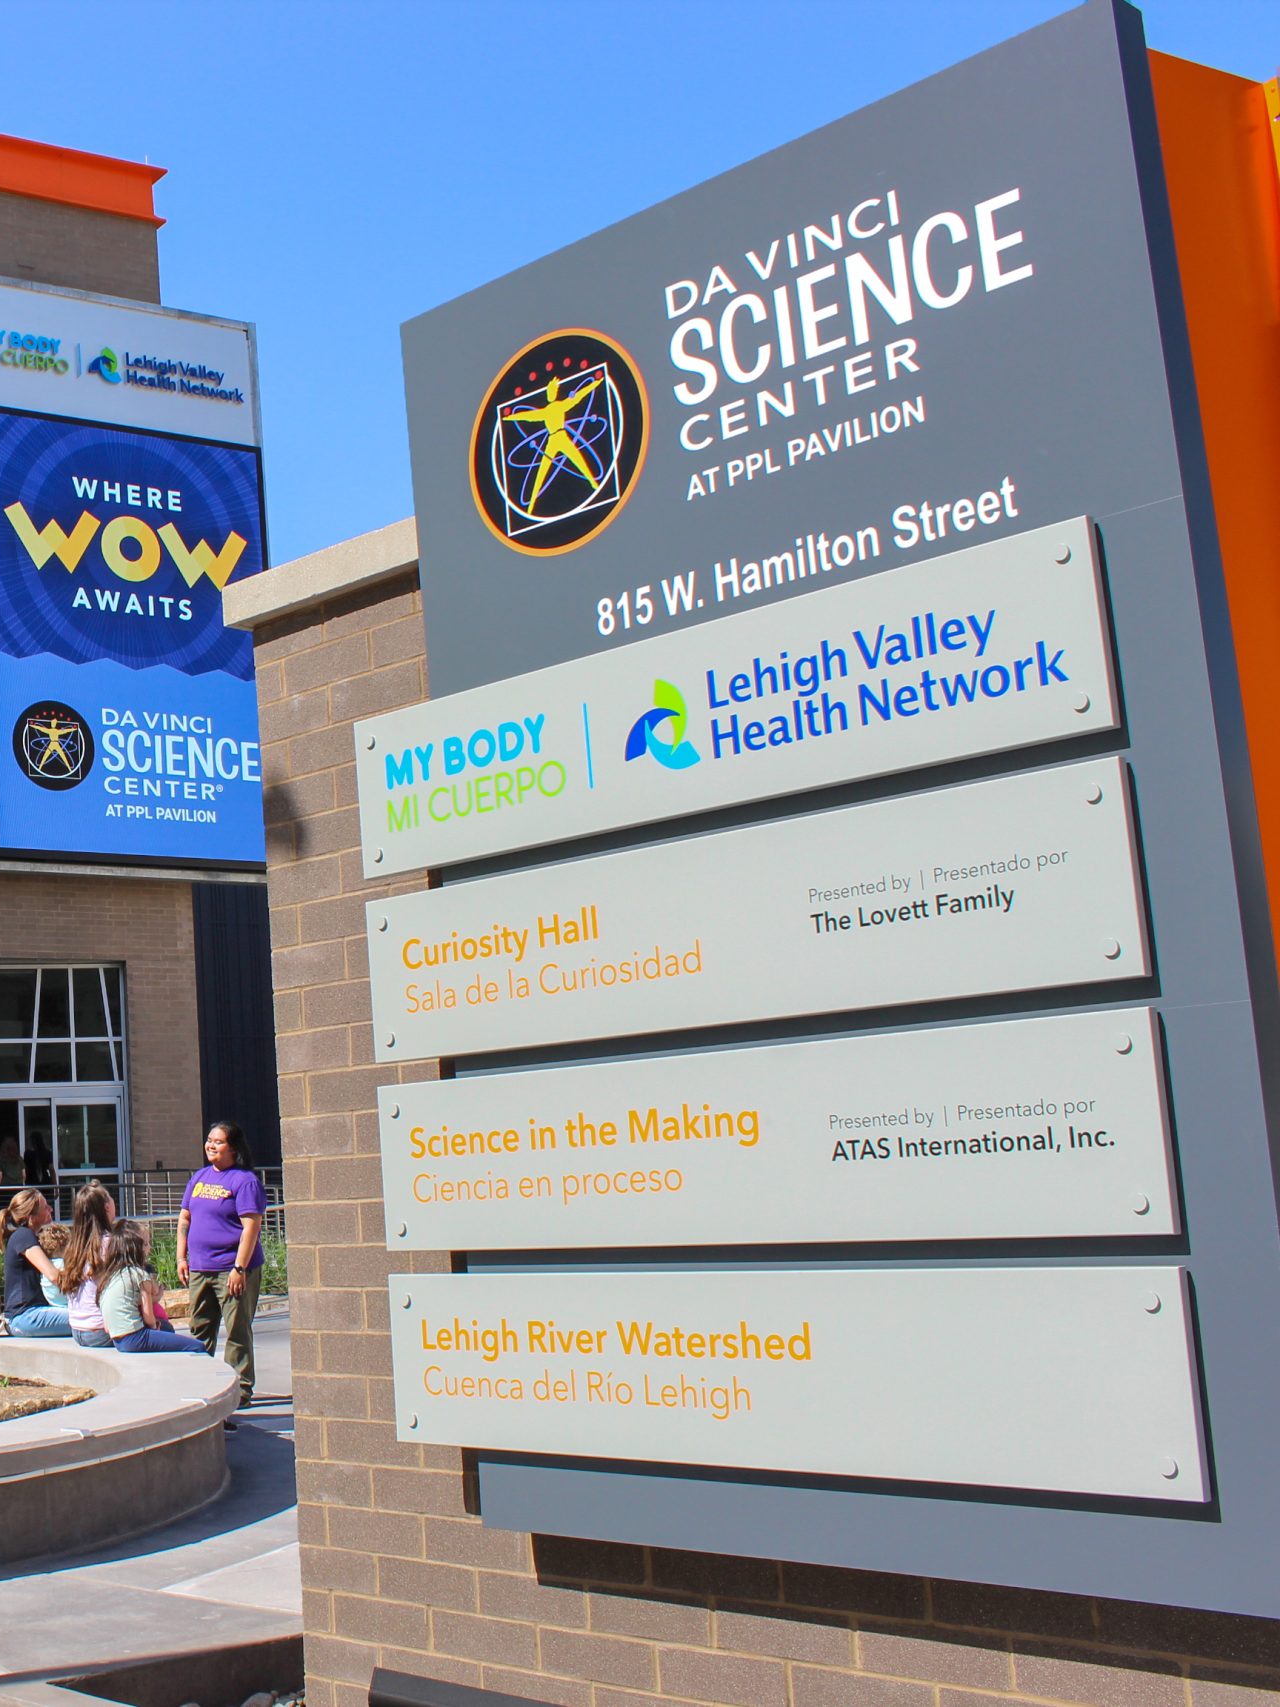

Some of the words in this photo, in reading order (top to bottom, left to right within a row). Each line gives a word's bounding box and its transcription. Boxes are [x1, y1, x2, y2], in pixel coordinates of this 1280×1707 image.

[664, 264, 738, 319] DA
[745, 190, 900, 281] VINCI
[669, 187, 1034, 407] SCIENCE
[0, 348, 70, 375] CUERPO
[10, 331, 61, 355] BODY
[125, 352, 178, 376] Lehigh
[179, 363, 225, 385] Valley
[126, 369, 176, 392] Health
[180, 378, 244, 404] Network
[679, 338, 920, 451] CENTER
[686, 466, 720, 501] AT
[726, 448, 781, 487] PPL
[787, 396, 926, 466] PAVILION
[72, 476, 183, 512] WHERE
[4, 501, 248, 592] WOW
[597, 586, 654, 636] 815
[661, 571, 704, 615] W.
[713, 525, 880, 602] Hamilton
[891, 476, 1019, 550] Street
[72, 587, 193, 621] AWAITS
[706, 637, 848, 709] Lehigh
[853, 609, 997, 670] Valley
[101, 708, 138, 728] DA
[142, 711, 212, 734] VINCI
[711, 694, 848, 759] Health
[861, 639, 1071, 727] Network
[102, 729, 261, 782] SCIENCE
[385, 745, 433, 790] MY
[443, 713, 546, 777] BODY
[105, 804, 123, 817] AT
[127, 806, 153, 819] PPL
[156, 807, 217, 823] PAVILION
[387, 791, 421, 833] MI
[428, 760, 567, 824] CUERPO
[808, 876, 887, 904] Presented
[891, 874, 911, 894] by
[933, 854, 1032, 883] Presentado
[1036, 850, 1069, 872] por
[810, 911, 852, 934] The
[858, 899, 930, 928] Lovett
[935, 884, 1015, 916] Family
[402, 924, 529, 970] Curiosity
[537, 905, 600, 948] Hall
[405, 980, 457, 1013] Sala
[465, 974, 500, 1006] de
[508, 968, 530, 999] la
[538, 938, 703, 995] Curiosidad
[409, 1126, 520, 1159] Science
[528, 1118, 556, 1150] in
[565, 1112, 617, 1148] the
[628, 1103, 760, 1147] Making
[829, 1108, 909, 1130] Presented
[914, 1107, 934, 1128] by
[957, 1098, 1058, 1121] Presentado
[1063, 1099, 1096, 1119] por
[831, 1137, 891, 1162] ATAS
[897, 1126, 1061, 1158] International,
[1068, 1126, 1116, 1149] Inc.
[413, 1170, 510, 1204] Ciencia
[519, 1175, 552, 1198] en
[562, 1168, 683, 1206] proceso
[421, 1317, 518, 1362] Lehigh
[527, 1320, 607, 1353] River
[616, 1321, 812, 1361] Watershed
[423, 1365, 523, 1400] Cuenca
[533, 1368, 577, 1402] del
[586, 1370, 634, 1404] Río
[644, 1374, 751, 1420] Lehigh
